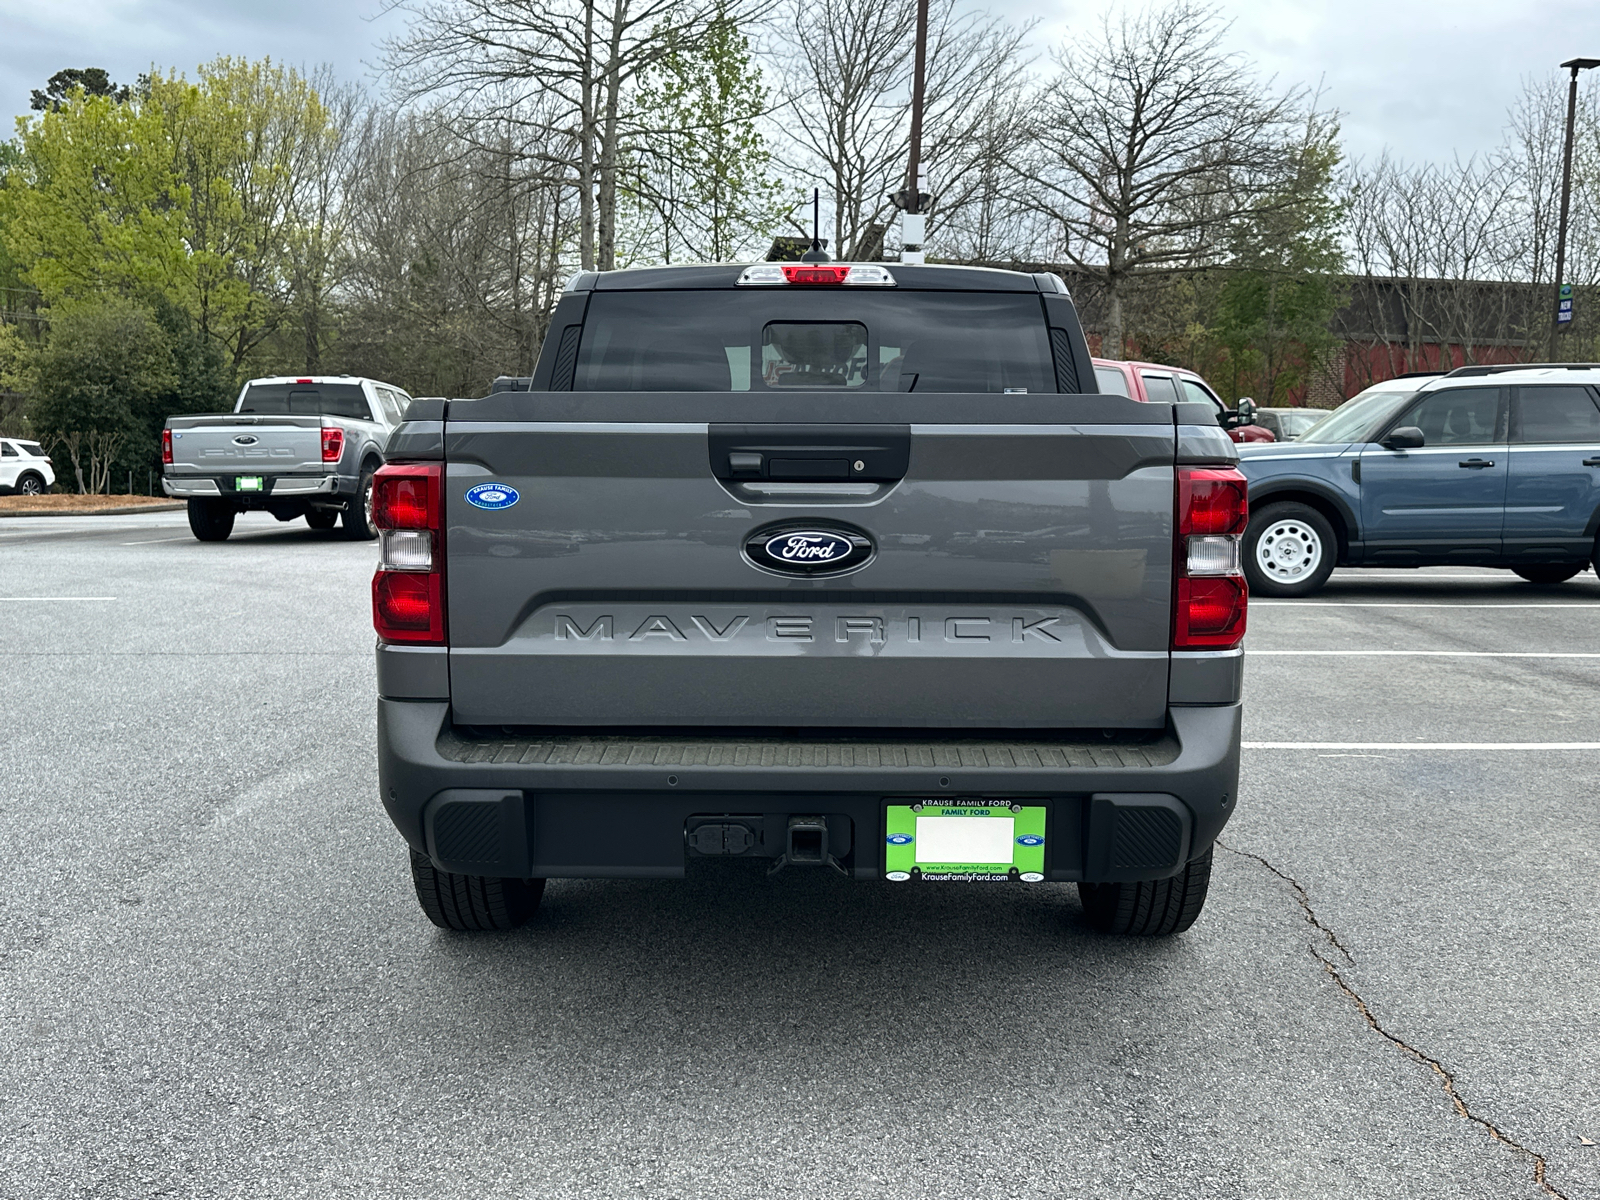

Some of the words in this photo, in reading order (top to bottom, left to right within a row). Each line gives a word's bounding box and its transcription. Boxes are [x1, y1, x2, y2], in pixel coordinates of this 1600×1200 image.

[198, 447, 295, 459] F-150
[473, 485, 494, 494] KRAUSE
[494, 485, 513, 494] FAMILY
[485, 492, 501, 500] Ford
[782, 536, 836, 558] Ford
[554, 614, 1063, 644] MAVERICK
[922, 799, 954, 807] KRAUSE
[921, 872, 1009, 883] KrauseFamilyFord.com
